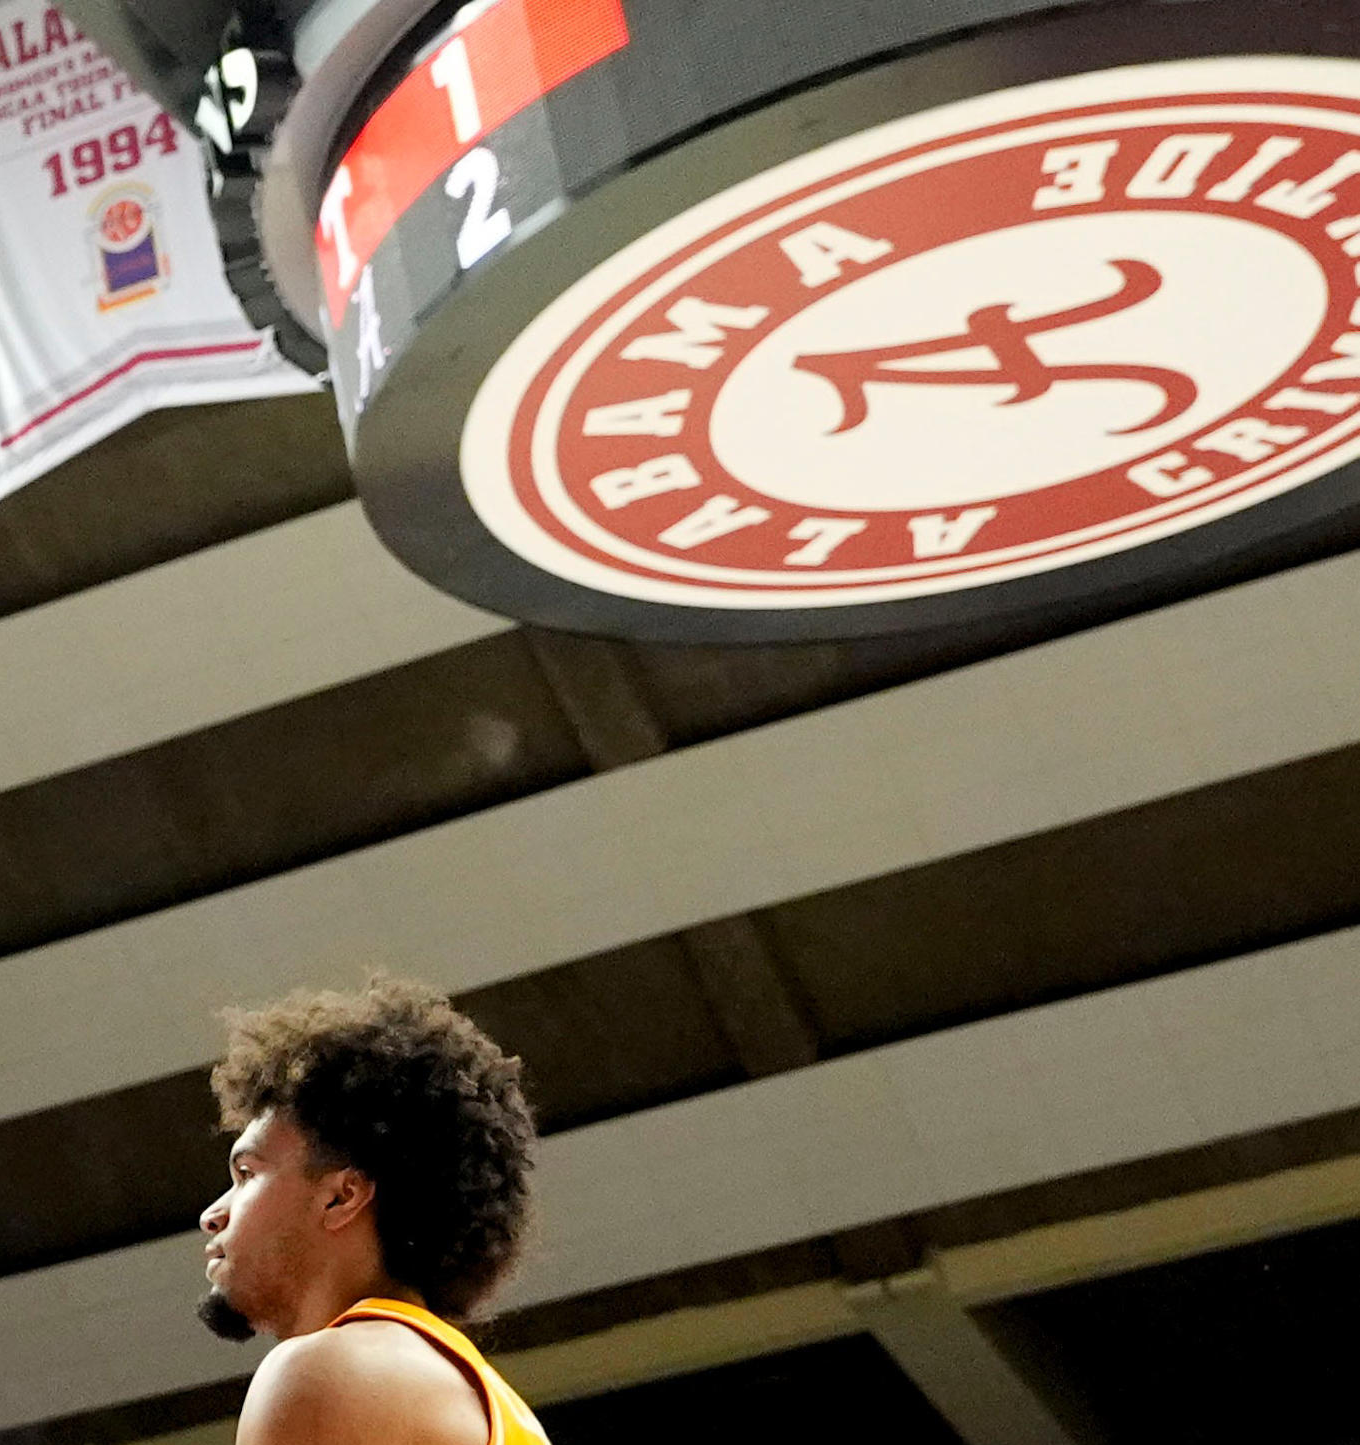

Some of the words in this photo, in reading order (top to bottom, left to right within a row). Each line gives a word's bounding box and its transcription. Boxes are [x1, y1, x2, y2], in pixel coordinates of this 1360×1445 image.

[430, 36, 482, 144] 1
[42, 112, 178, 197] 1994
[445, 146, 512, 269] 2
[583, 221, 997, 567] ALABAMA
